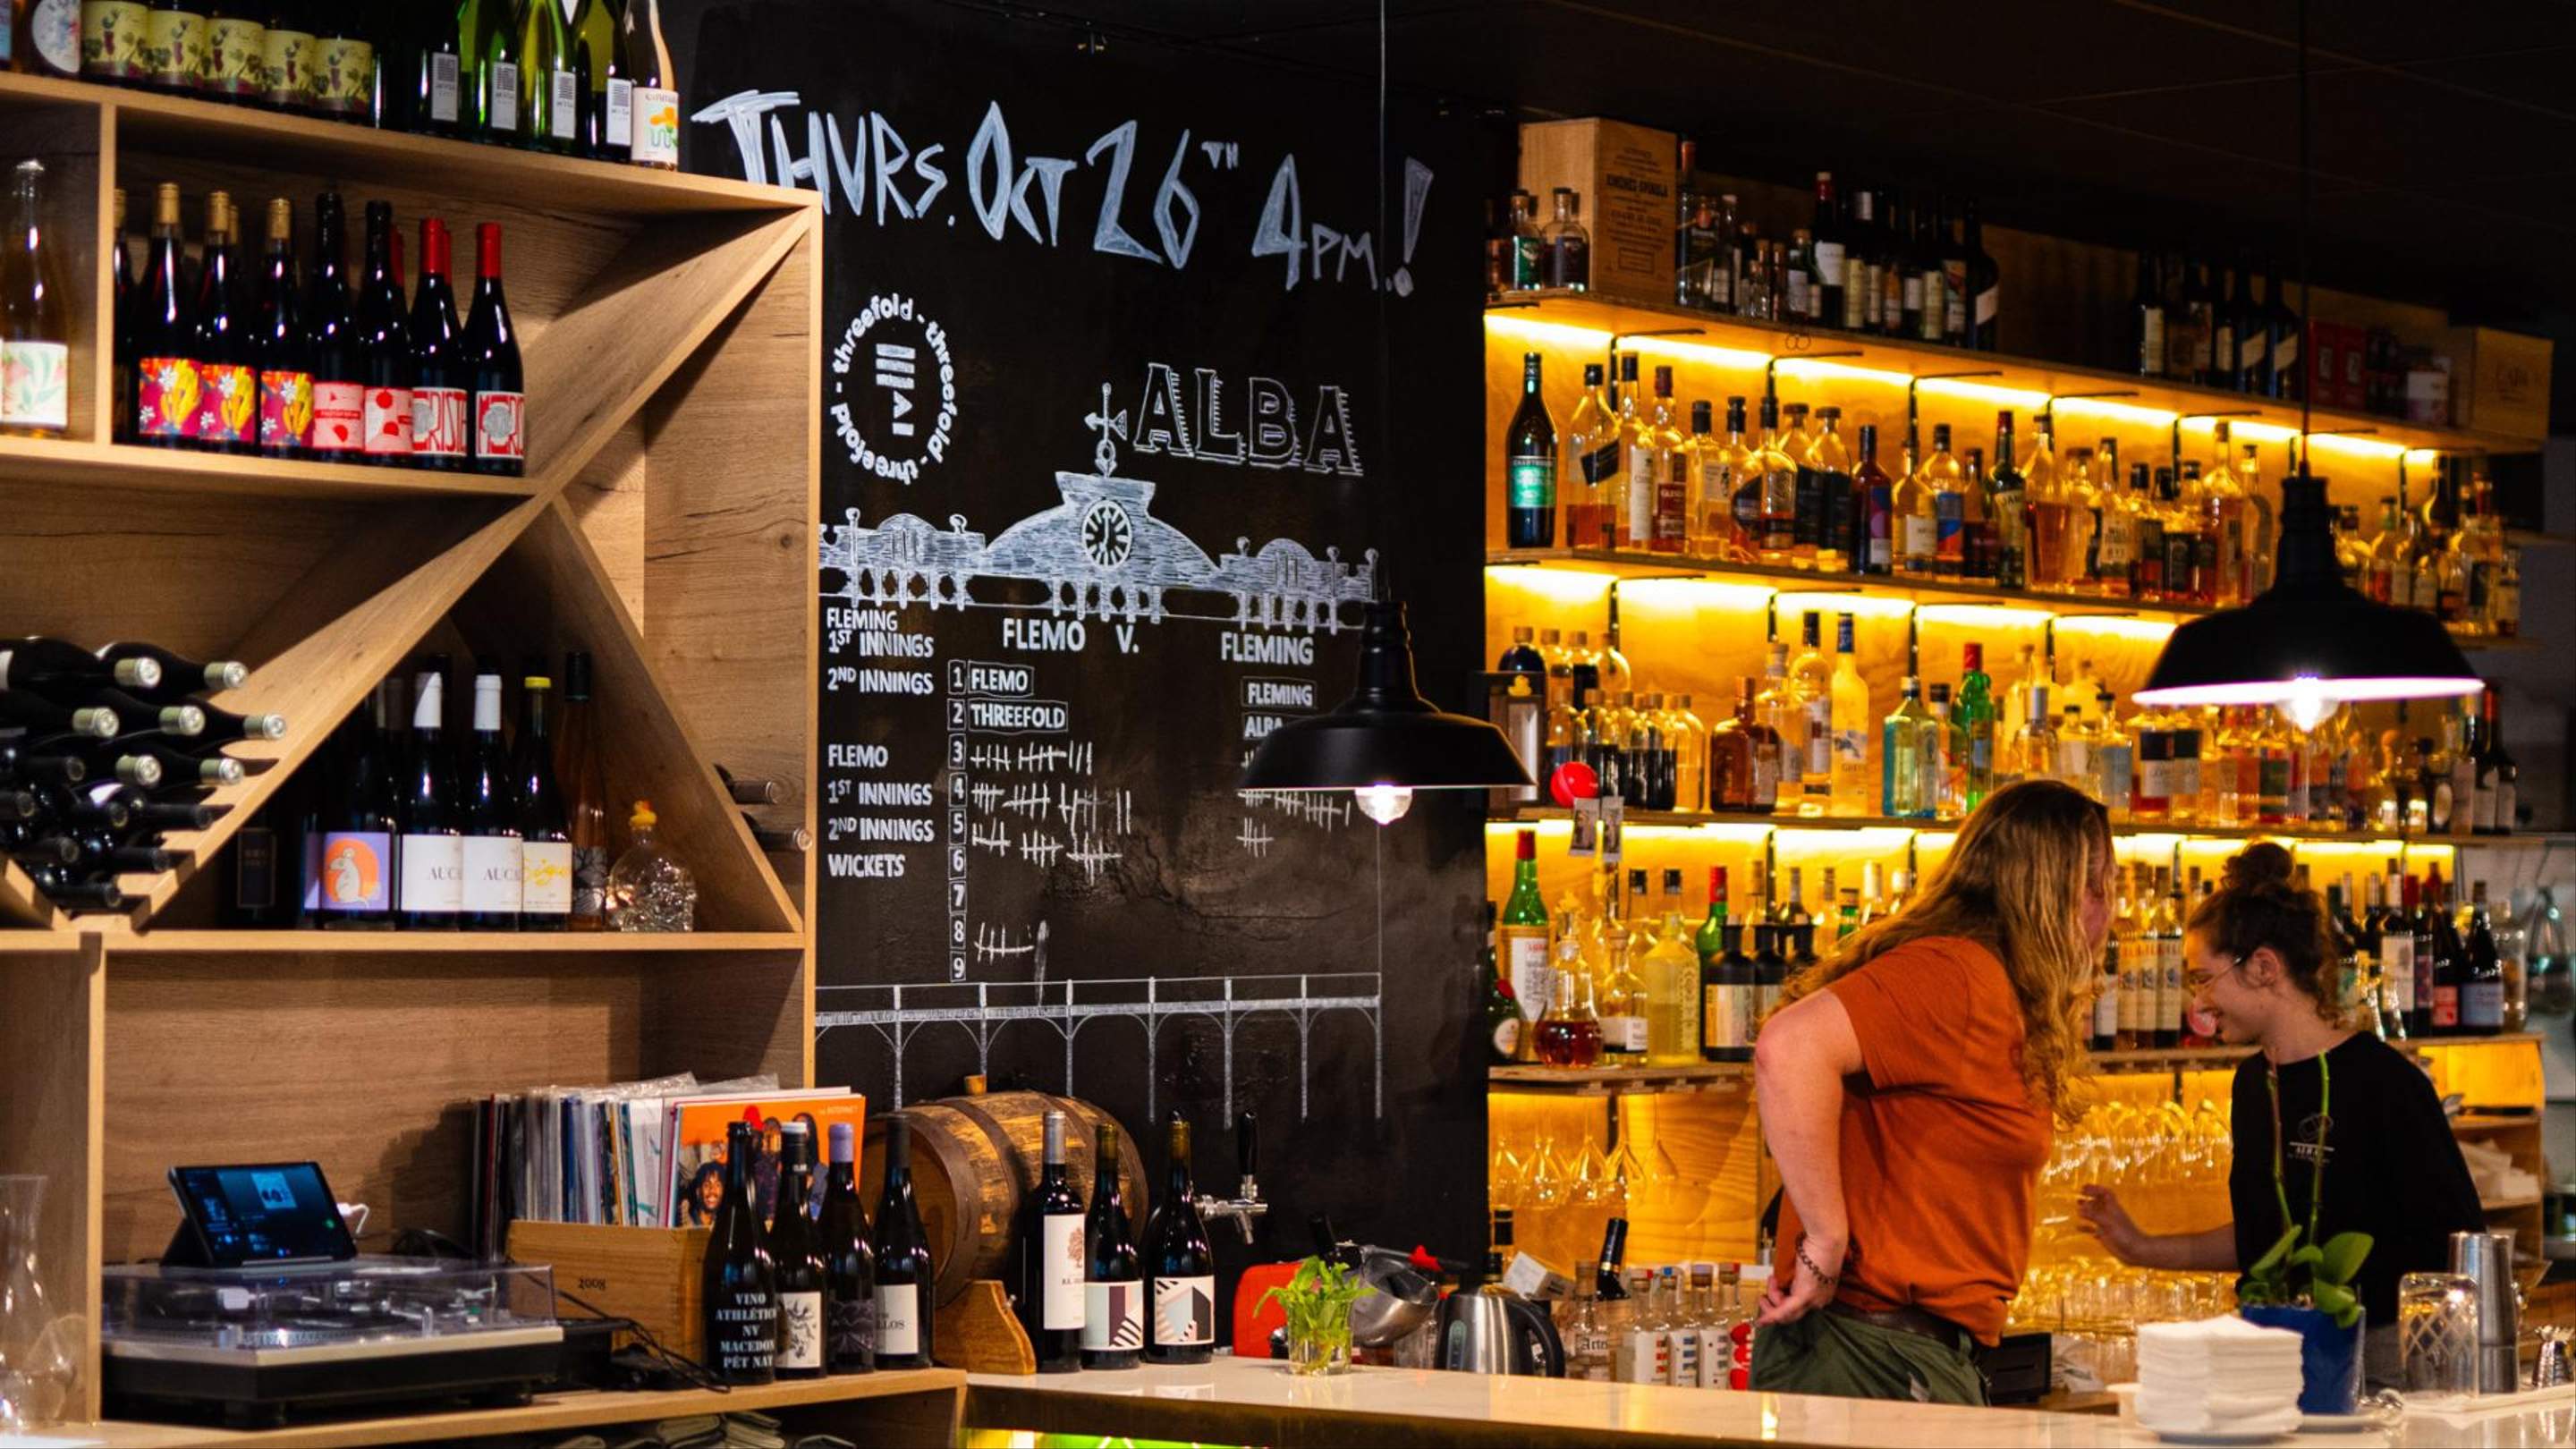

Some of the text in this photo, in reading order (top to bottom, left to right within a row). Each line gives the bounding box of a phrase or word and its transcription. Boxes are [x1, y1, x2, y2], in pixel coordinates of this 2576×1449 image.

[833, 292, 913, 373] threefold
[925, 320, 958, 463] threefold
[1133, 362, 1363, 477] ALBA
[830, 402, 919, 486] threefold
[826, 607, 898, 631] FLEMING
[828, 630, 935, 657] 1ST INNINGS
[1003, 618, 1314, 665] FLEMO V. FLEMING
[827, 666, 935, 695] 2ND INNINGS
[953, 666, 1029, 692] 1 FLEMO
[1248, 682, 1313, 707] FLEMING
[952, 702, 1065, 729] 2 THREEFOLD
[827, 744, 889, 768] FLEMO
[952, 741, 963, 763] 3
[827, 779, 933, 806] 1ST INNINGS
[953, 777, 964, 800] 4
[828, 817, 935, 843] 2ND INNINGS
[953, 813, 963, 835] 5
[827, 853, 906, 879] WICKETS
[953, 850, 964, 872] 6
[953, 885, 964, 907] 7
[953, 919, 964, 943] 8
[953, 957, 964, 979] 9
[735, 1292, 767, 1305] VINO
